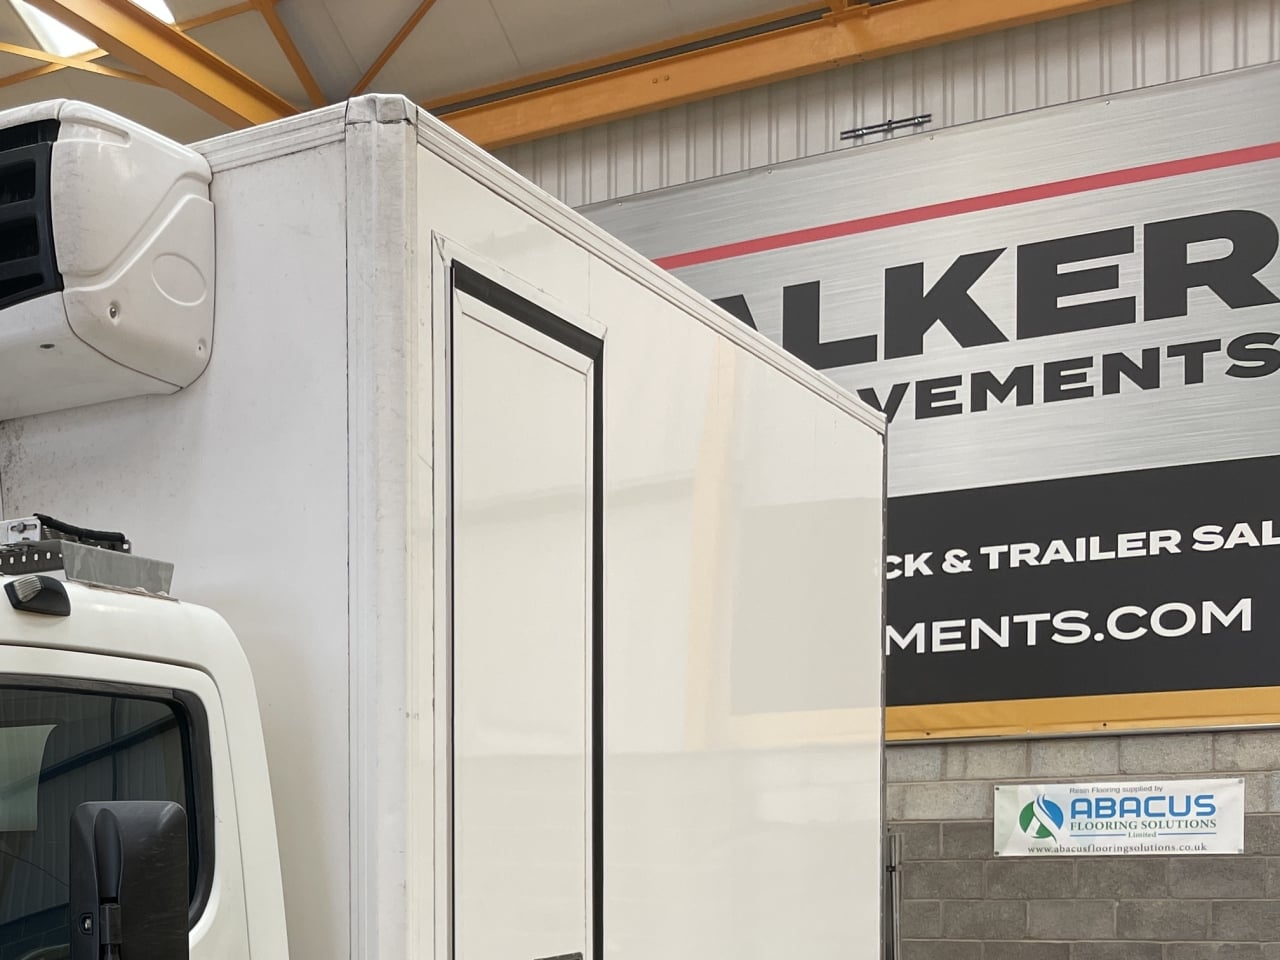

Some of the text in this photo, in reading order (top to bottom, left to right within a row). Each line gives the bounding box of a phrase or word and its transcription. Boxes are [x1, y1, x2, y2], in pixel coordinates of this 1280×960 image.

[710, 209, 1280, 371] LKER
[856, 332, 1280, 424] VEMENTS
[941, 548, 974, 574] &
[980, 529, 1182, 570] TRAILER
[1191, 520, 1280, 552] SAL
[885, 598, 1253, 656] MENTS.COM
[1091, 786, 1121, 794] Flooring
[1122, 785, 1153, 793] supplied
[1070, 794, 1217, 820] ABACUS
[1070, 818, 1217, 831] FLOORING SOLUTIONS
[1128, 830, 1157, 838] Limited
[1027, 841, 1208, 854] www.abacusflooringsolutions.co.uk
